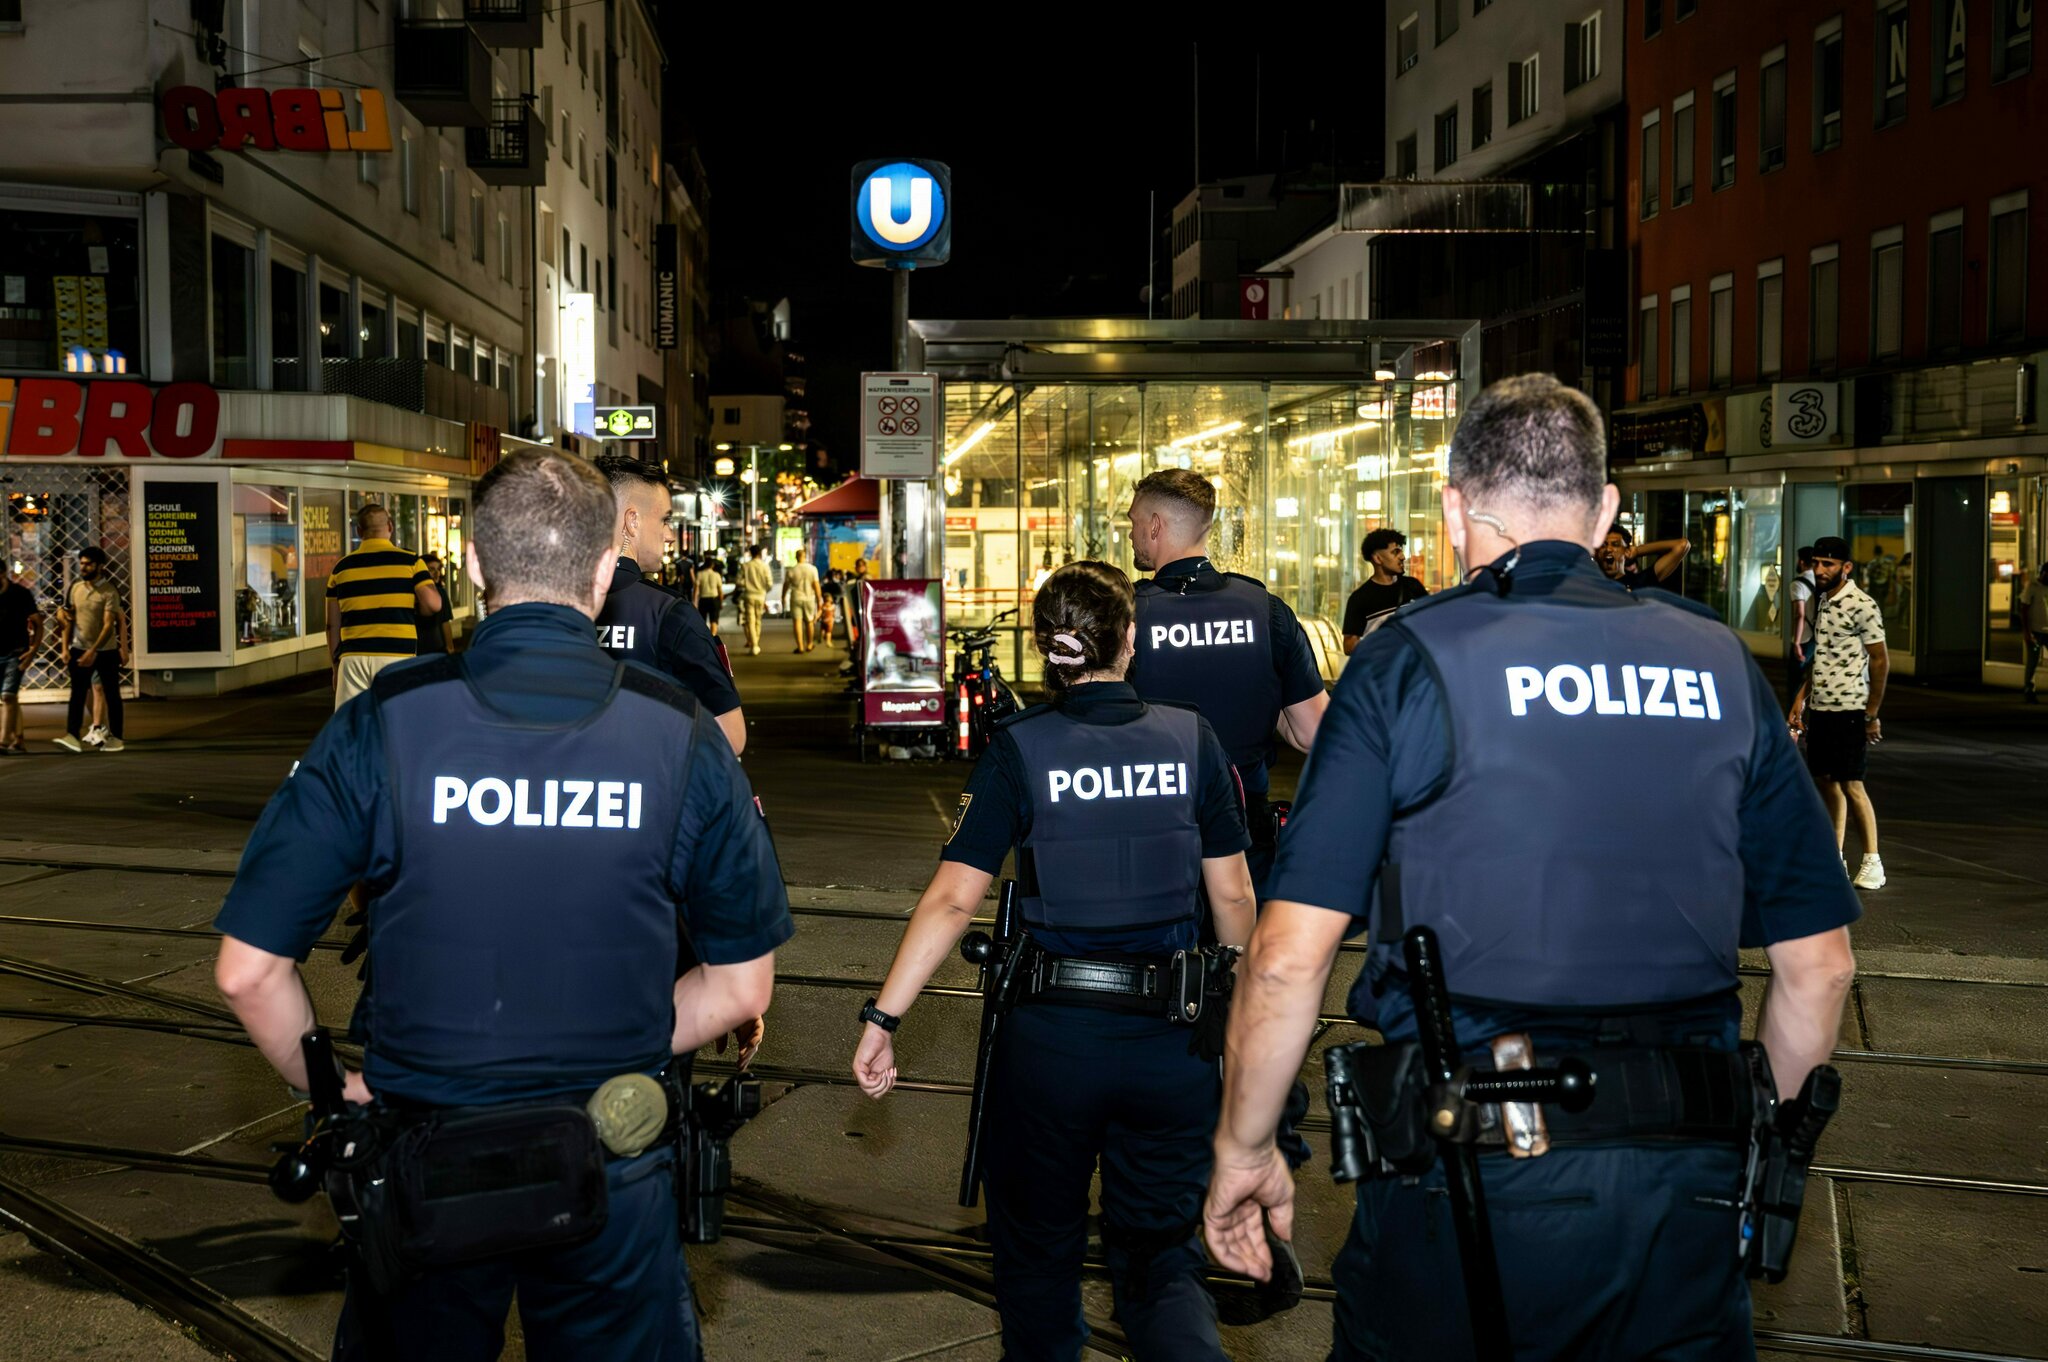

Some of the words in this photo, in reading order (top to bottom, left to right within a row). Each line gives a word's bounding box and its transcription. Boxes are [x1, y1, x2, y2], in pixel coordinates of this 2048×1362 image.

[870, 177, 932, 244] U
[660, 271, 674, 346] HUMANIC
[1788, 388, 1827, 439] 3
[148, 504, 181, 512] SCHULE
[148, 512, 197, 520] SCHREIBEN
[303, 506, 330, 529] SCHULE
[149, 537, 187, 545] TASCHEN
[149, 545, 195, 553] SCHENKEN
[150, 586, 201, 594] MULTIMEDIA
[1150, 619, 1254, 650] POLIZEI
[1505, 663, 1722, 721] POLIZEI
[882, 700, 922, 713] Magenta
[1048, 762, 1187, 803] POLIZEI
[433, 776, 643, 829] POLIZEI
